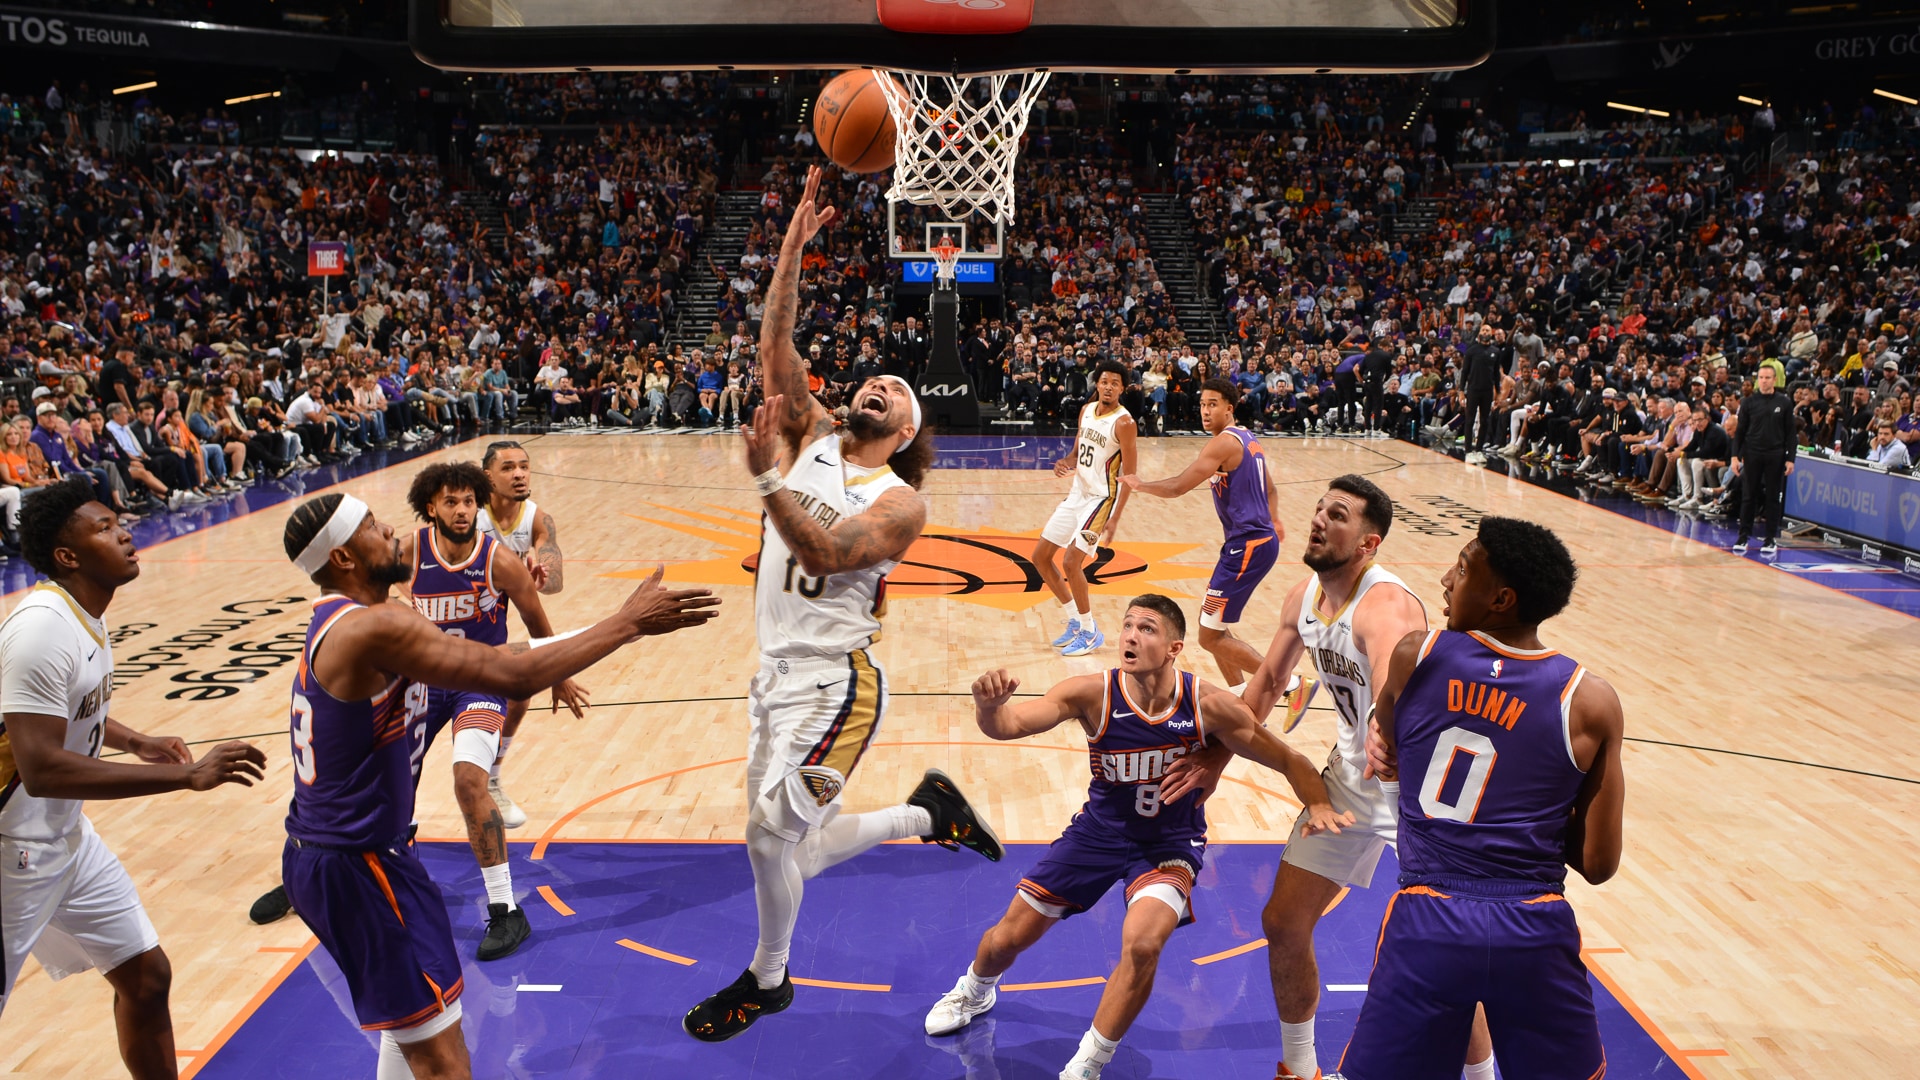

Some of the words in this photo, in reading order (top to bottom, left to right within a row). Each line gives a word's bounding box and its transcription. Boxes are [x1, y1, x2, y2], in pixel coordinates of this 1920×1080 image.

[74, 26, 149, 47] TEQUILA
[1815, 36, 1882, 60] GREY
[315, 250, 338, 269] THREE
[931, 263, 987, 275] FDUEL
[920, 384, 968, 397] KIA
[1079, 443, 1095, 468] 25
[1815, 481, 1878, 517] FANDUEL
[464, 568, 485, 577] PayPal
[1318, 647, 1366, 687] ORLEANS
[73, 681, 102, 722] NEW
[466, 701, 503, 712] PHOENIX
[1326, 681, 1360, 728] 17
[1447, 678, 1527, 731] DUNN
[1168, 720, 1194, 729] PayPal
[1101, 746, 1187, 782] SUNS
[1418, 726, 1498, 824] 0
[1135, 784, 1161, 818] 8
